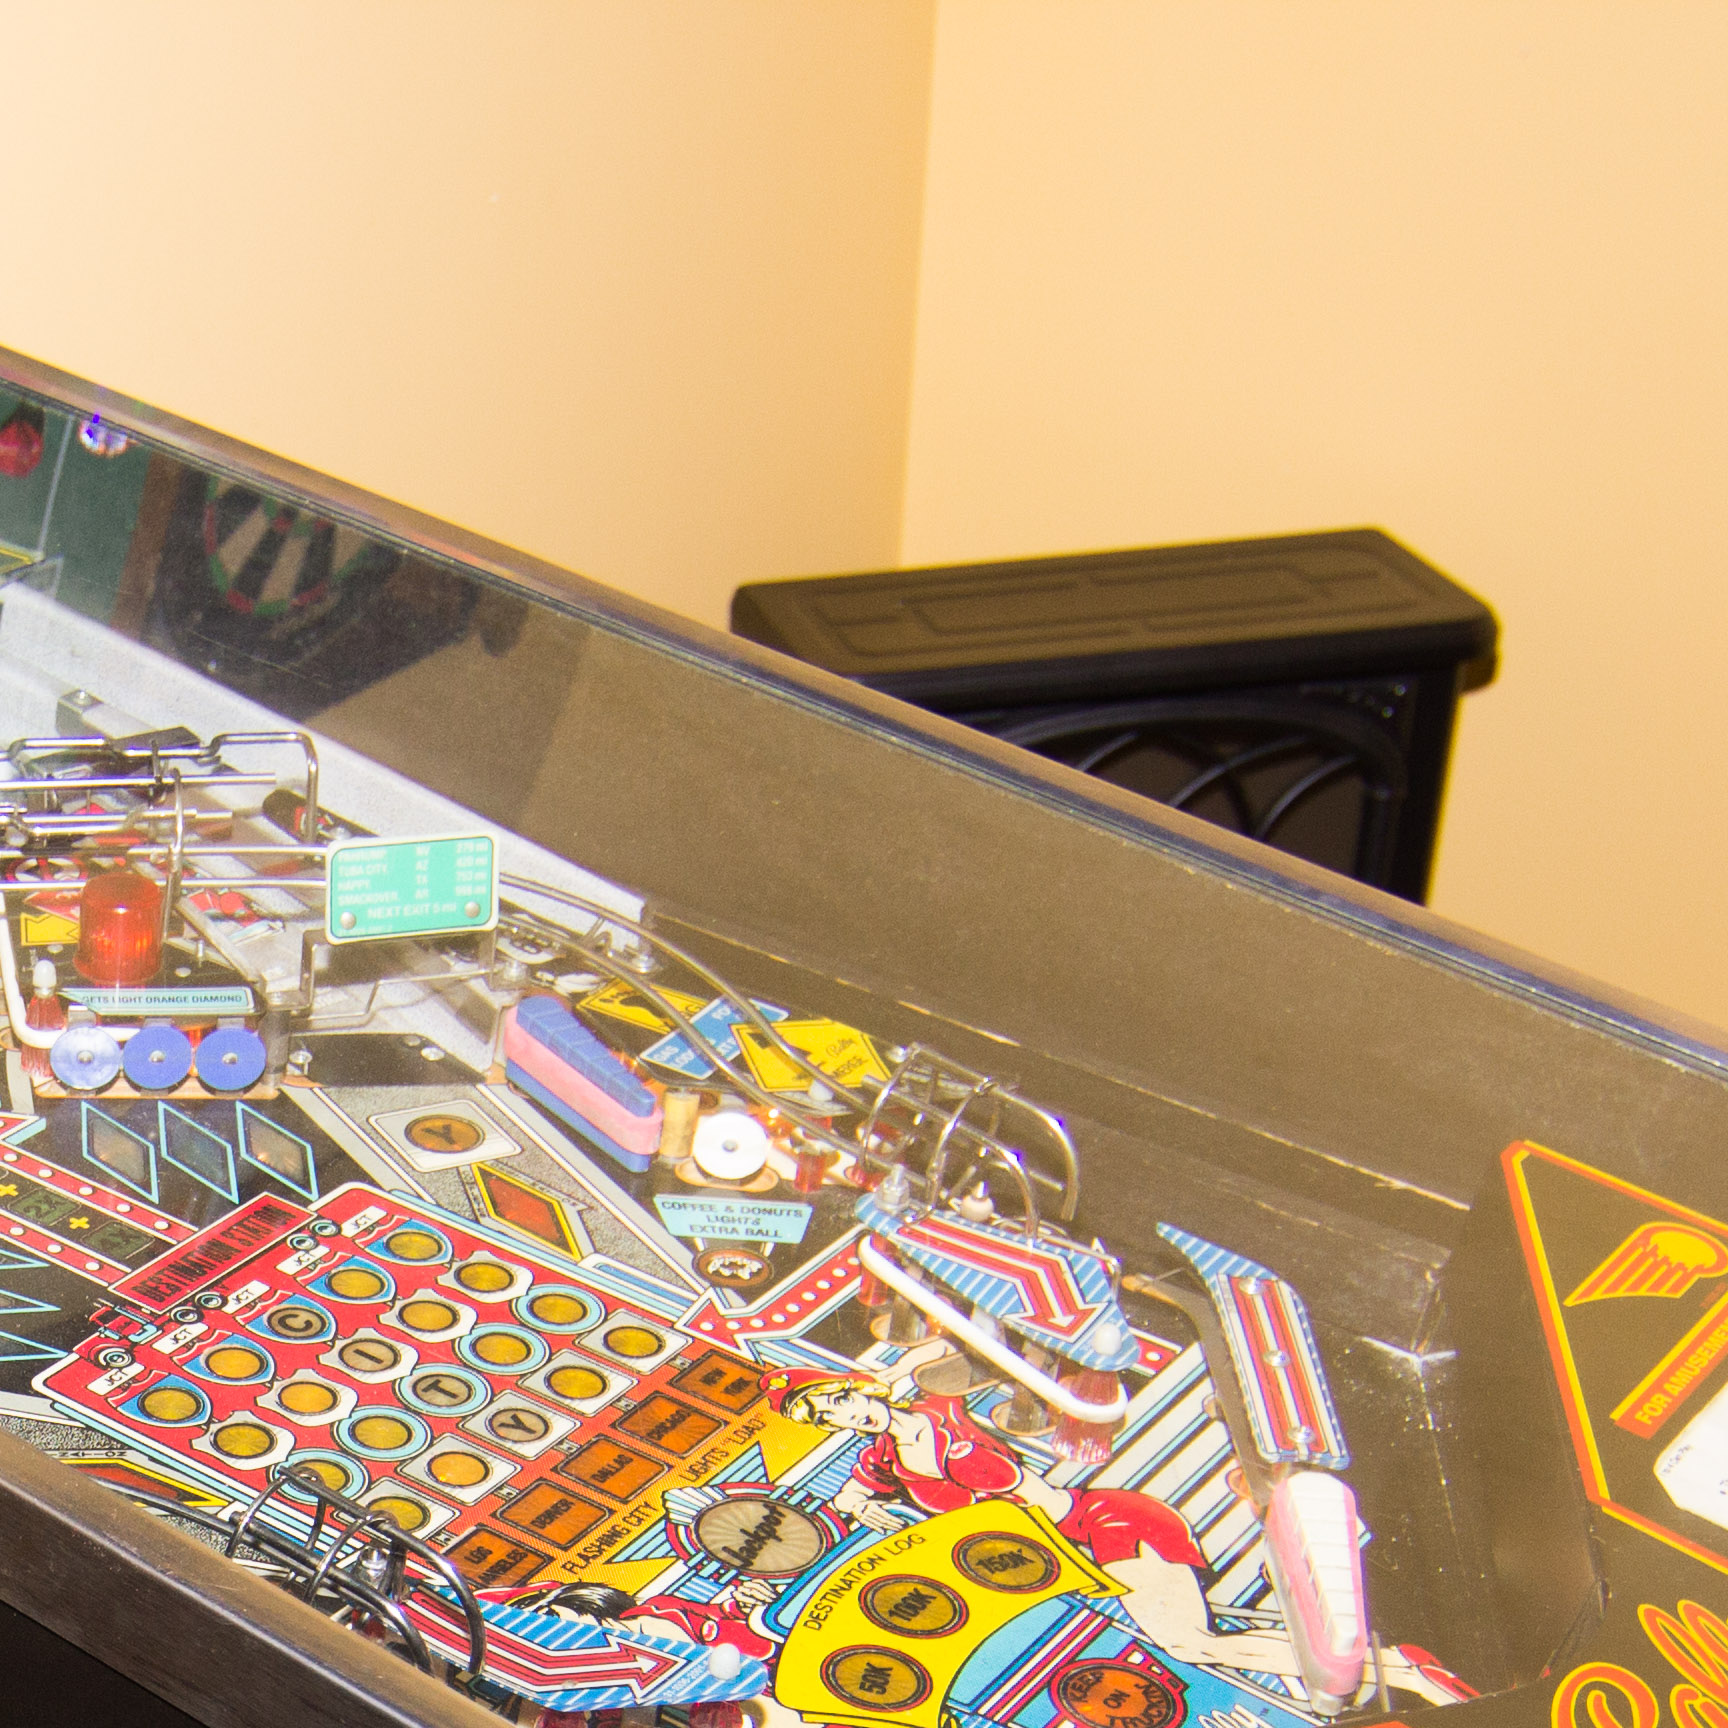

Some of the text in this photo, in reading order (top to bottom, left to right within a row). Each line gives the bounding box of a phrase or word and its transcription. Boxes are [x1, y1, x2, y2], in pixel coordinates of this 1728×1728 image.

[145, 995, 190, 1004] ORANGE
[192, 995, 242, 1003] DIAMOND
[419, 1123, 461, 1147] Y
[349, 1212, 378, 1230] JCT
[661, 1201, 803, 1218] COFFEE DONUTS
[706, 1215, 761, 1226] LIGHTS
[689, 1224, 783, 1238] EXTRA BALL
[130, 1203, 297, 1303] DESTINATION STATION
[292, 1250, 318, 1268] JCT
[232, 1287, 259, 1306] JCT
[278, 1313, 313, 1335] C
[170, 1328, 196, 1346] JCT
[105, 1367, 130, 1386] JCT
[428, 1378, 459, 1400] T
[1634, 1393, 1666, 1425] FOR
[498, 1413, 537, 1436] Y
[645, 1408, 694, 1442] CHICAGO
[590, 1453, 634, 1483] DALLAS
[562, 1412, 768, 1576] FLASHING CITY LIGHTS "LOAD"
[530, 1498, 576, 1531] DENVER
[722, 1502, 787, 1570] Jackpot
[471, 1546, 494, 1565] LOS
[477, 1547, 530, 1586] ANGELES
[975, 1546, 1028, 1576] 150K
[802, 1532, 927, 1632] DESTINATION LOG
[887, 1588, 938, 1621] 100K
[859, 1661, 895, 1696] 50K
[1068, 1670, 1105, 1703] KEEP
[1103, 1688, 1131, 1709] ON
